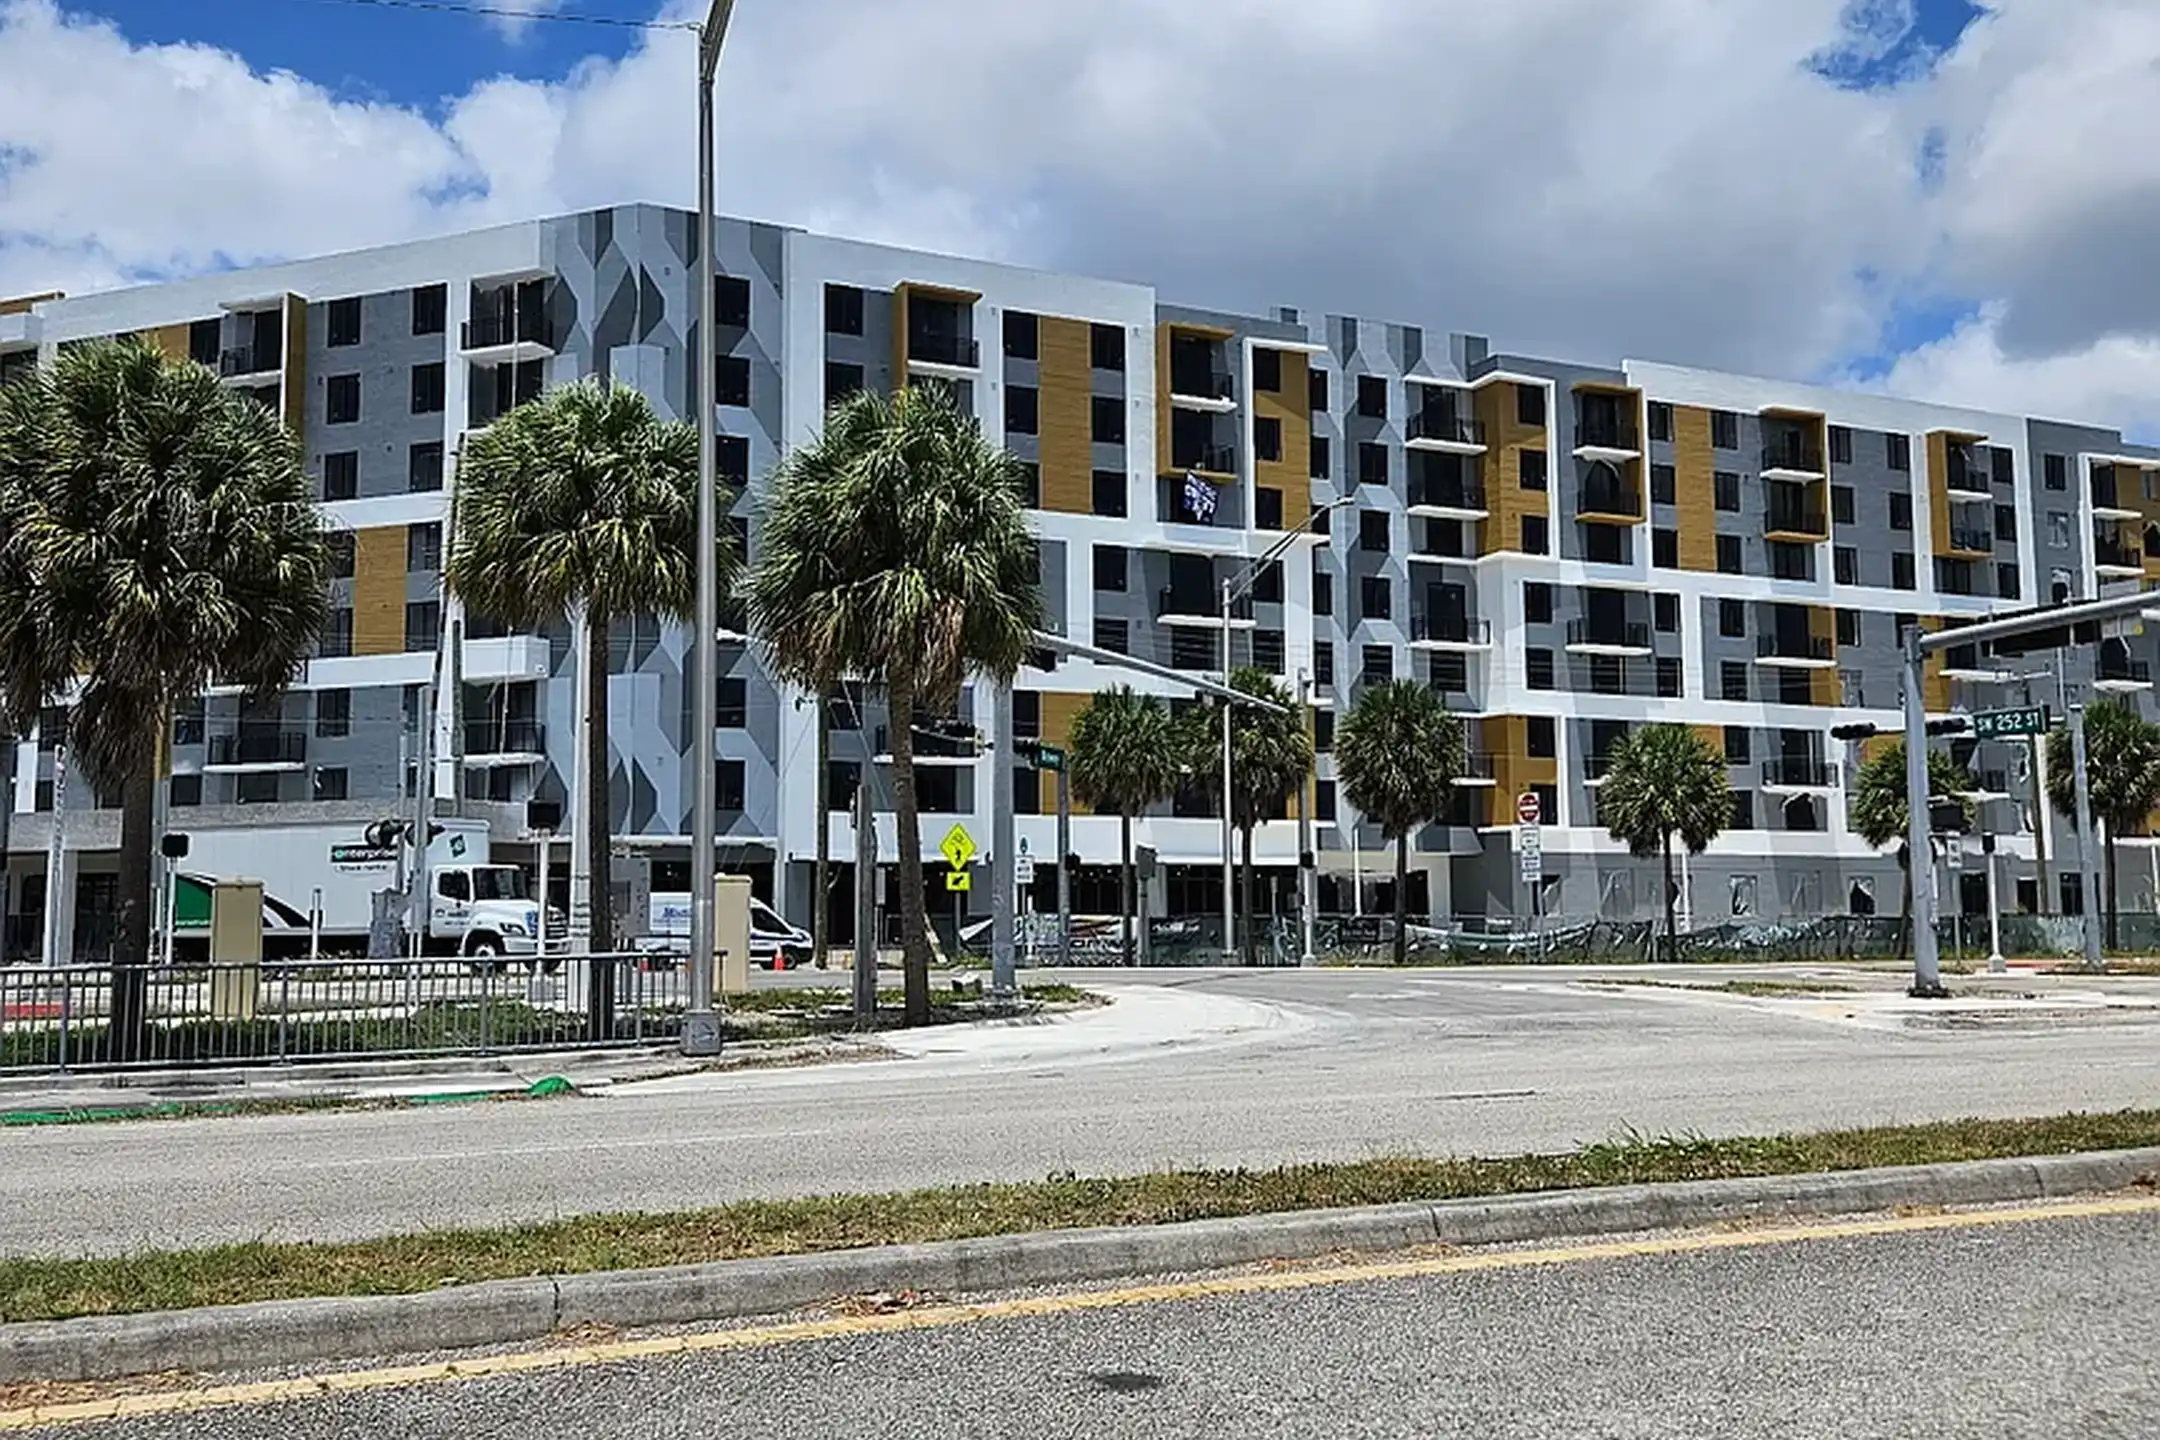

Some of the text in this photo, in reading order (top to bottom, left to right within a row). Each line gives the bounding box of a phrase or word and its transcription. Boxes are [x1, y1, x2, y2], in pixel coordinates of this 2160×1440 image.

[1995, 712, 2023, 731] 252
[2025, 711, 2039, 727] ST
[334, 847, 399, 860] enterprise
